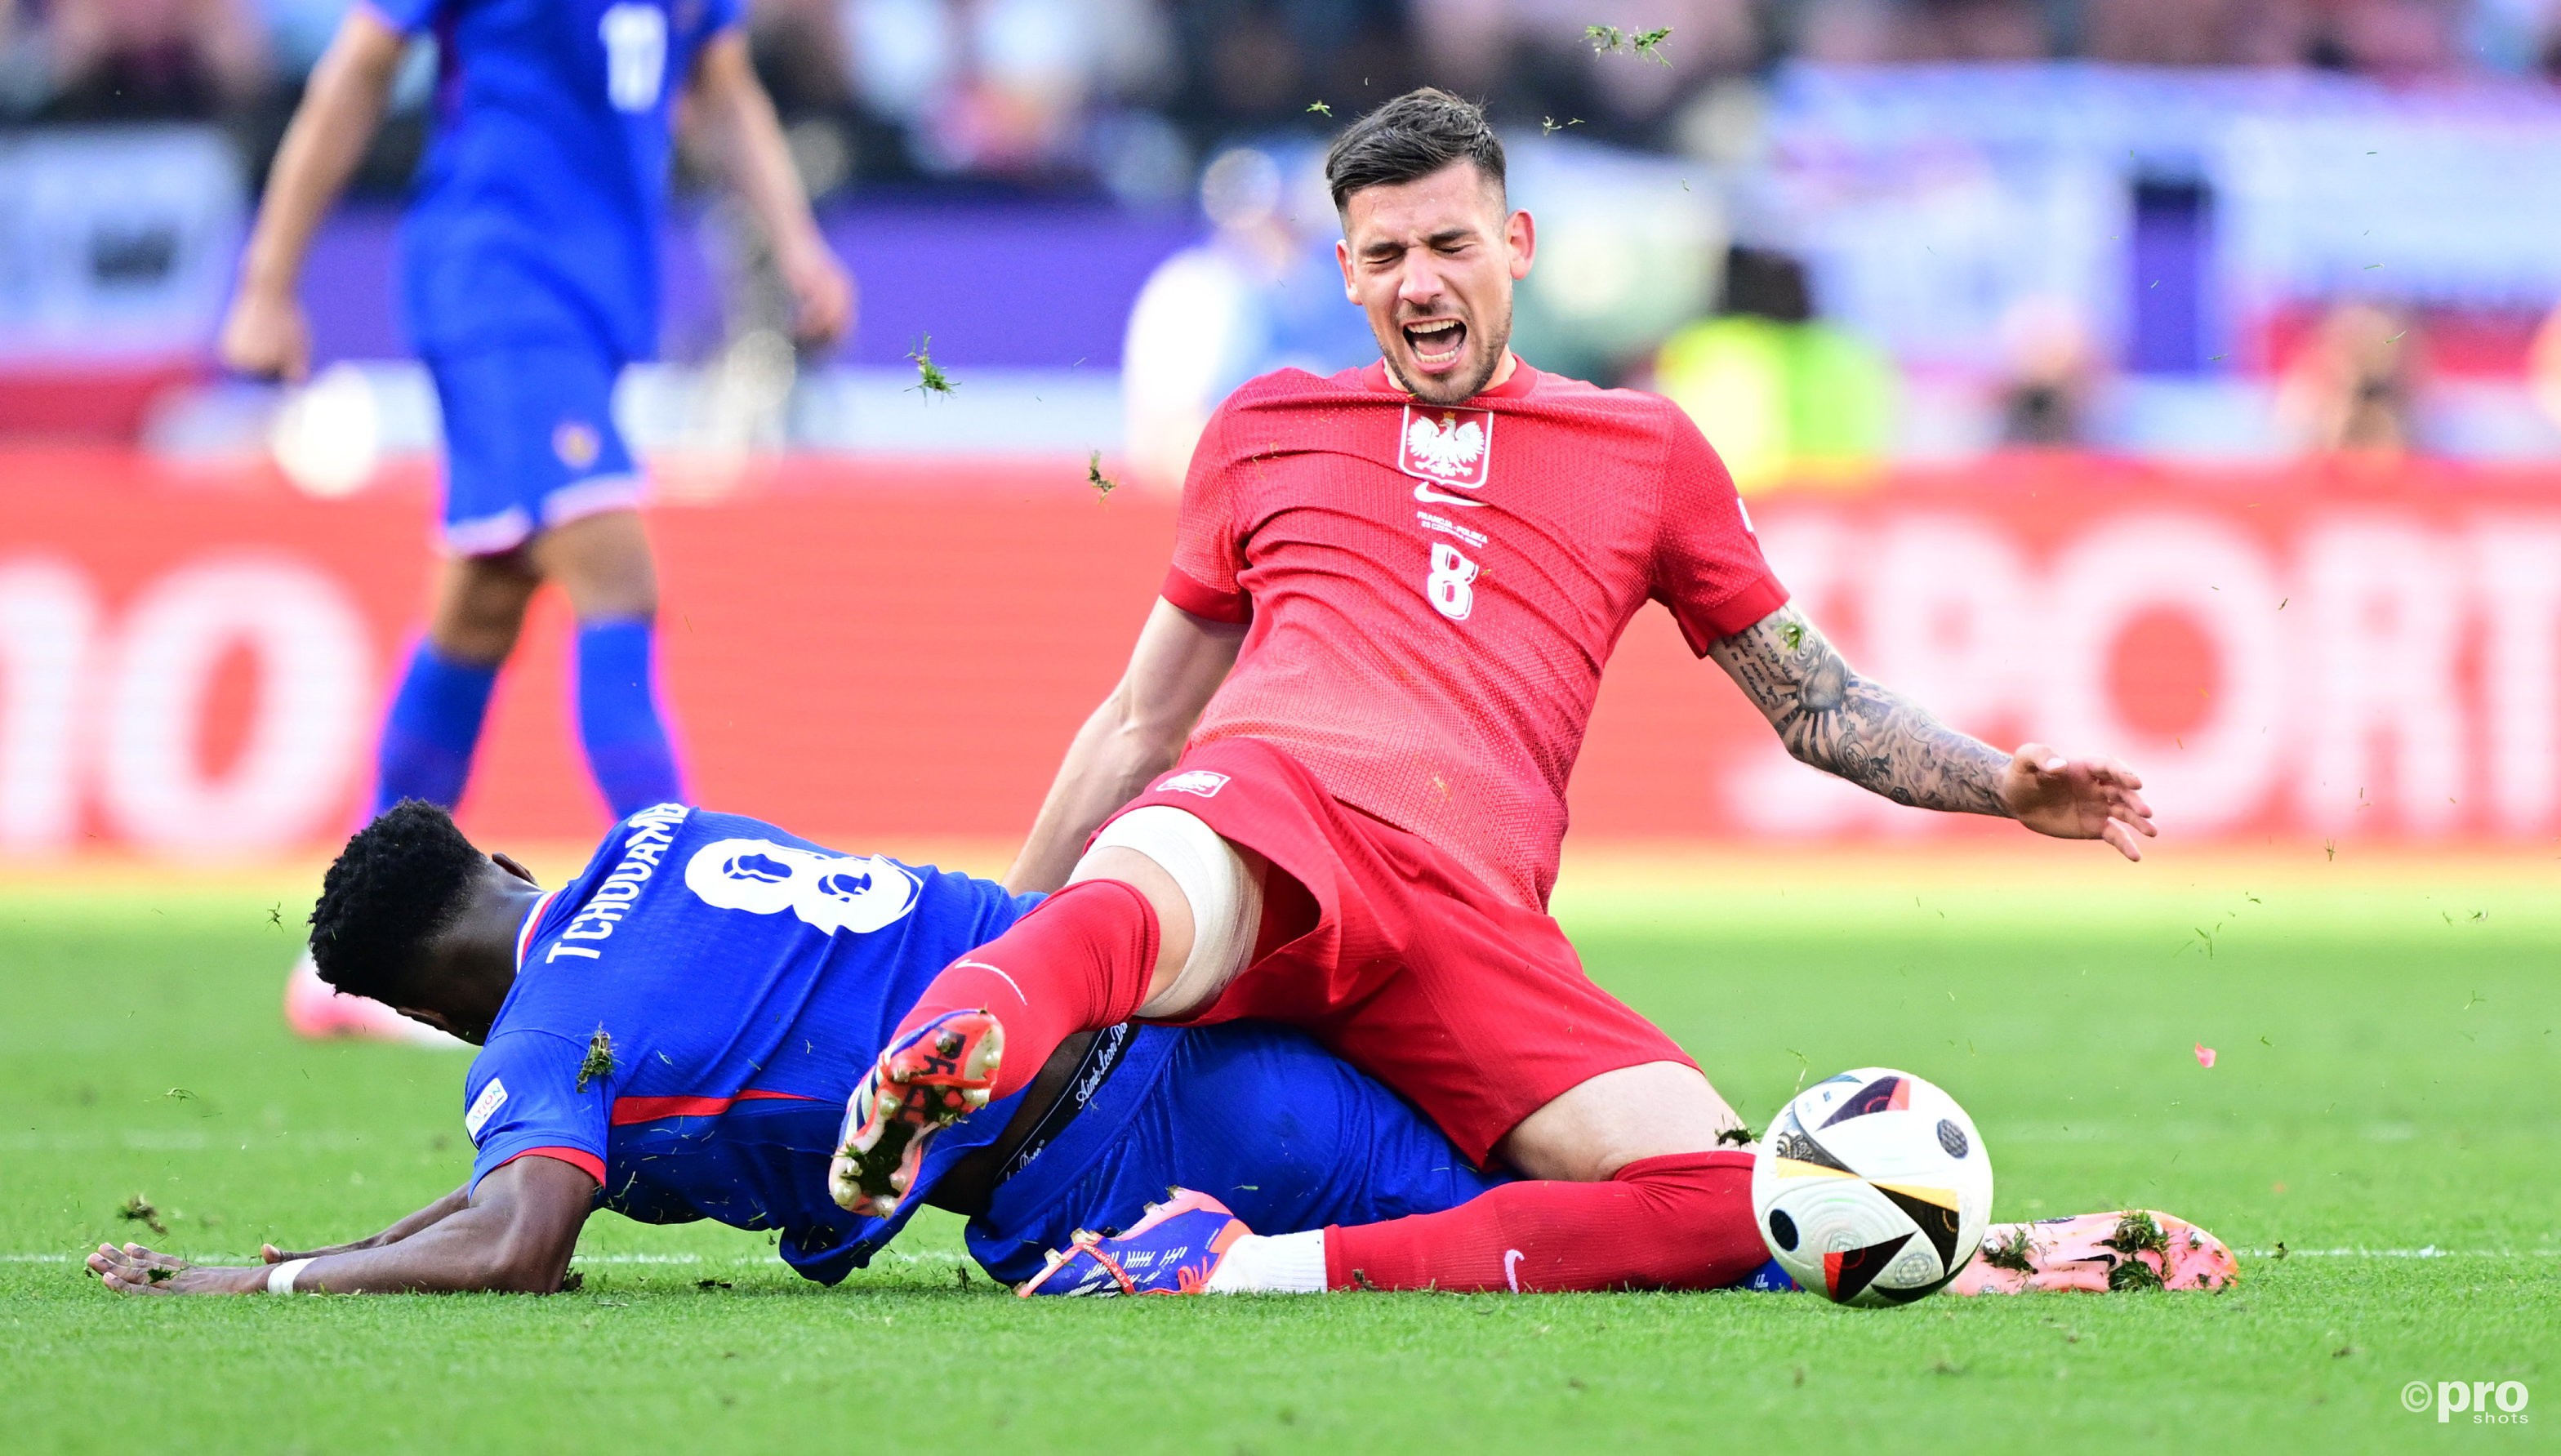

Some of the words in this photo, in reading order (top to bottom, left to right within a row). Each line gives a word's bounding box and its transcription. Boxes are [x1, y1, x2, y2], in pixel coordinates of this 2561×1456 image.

[1427, 541, 1479, 621] 8
[545, 803, 690, 964] TCHOUAME
[684, 838, 924, 937] 8
[471, 1084, 501, 1124] ATION
